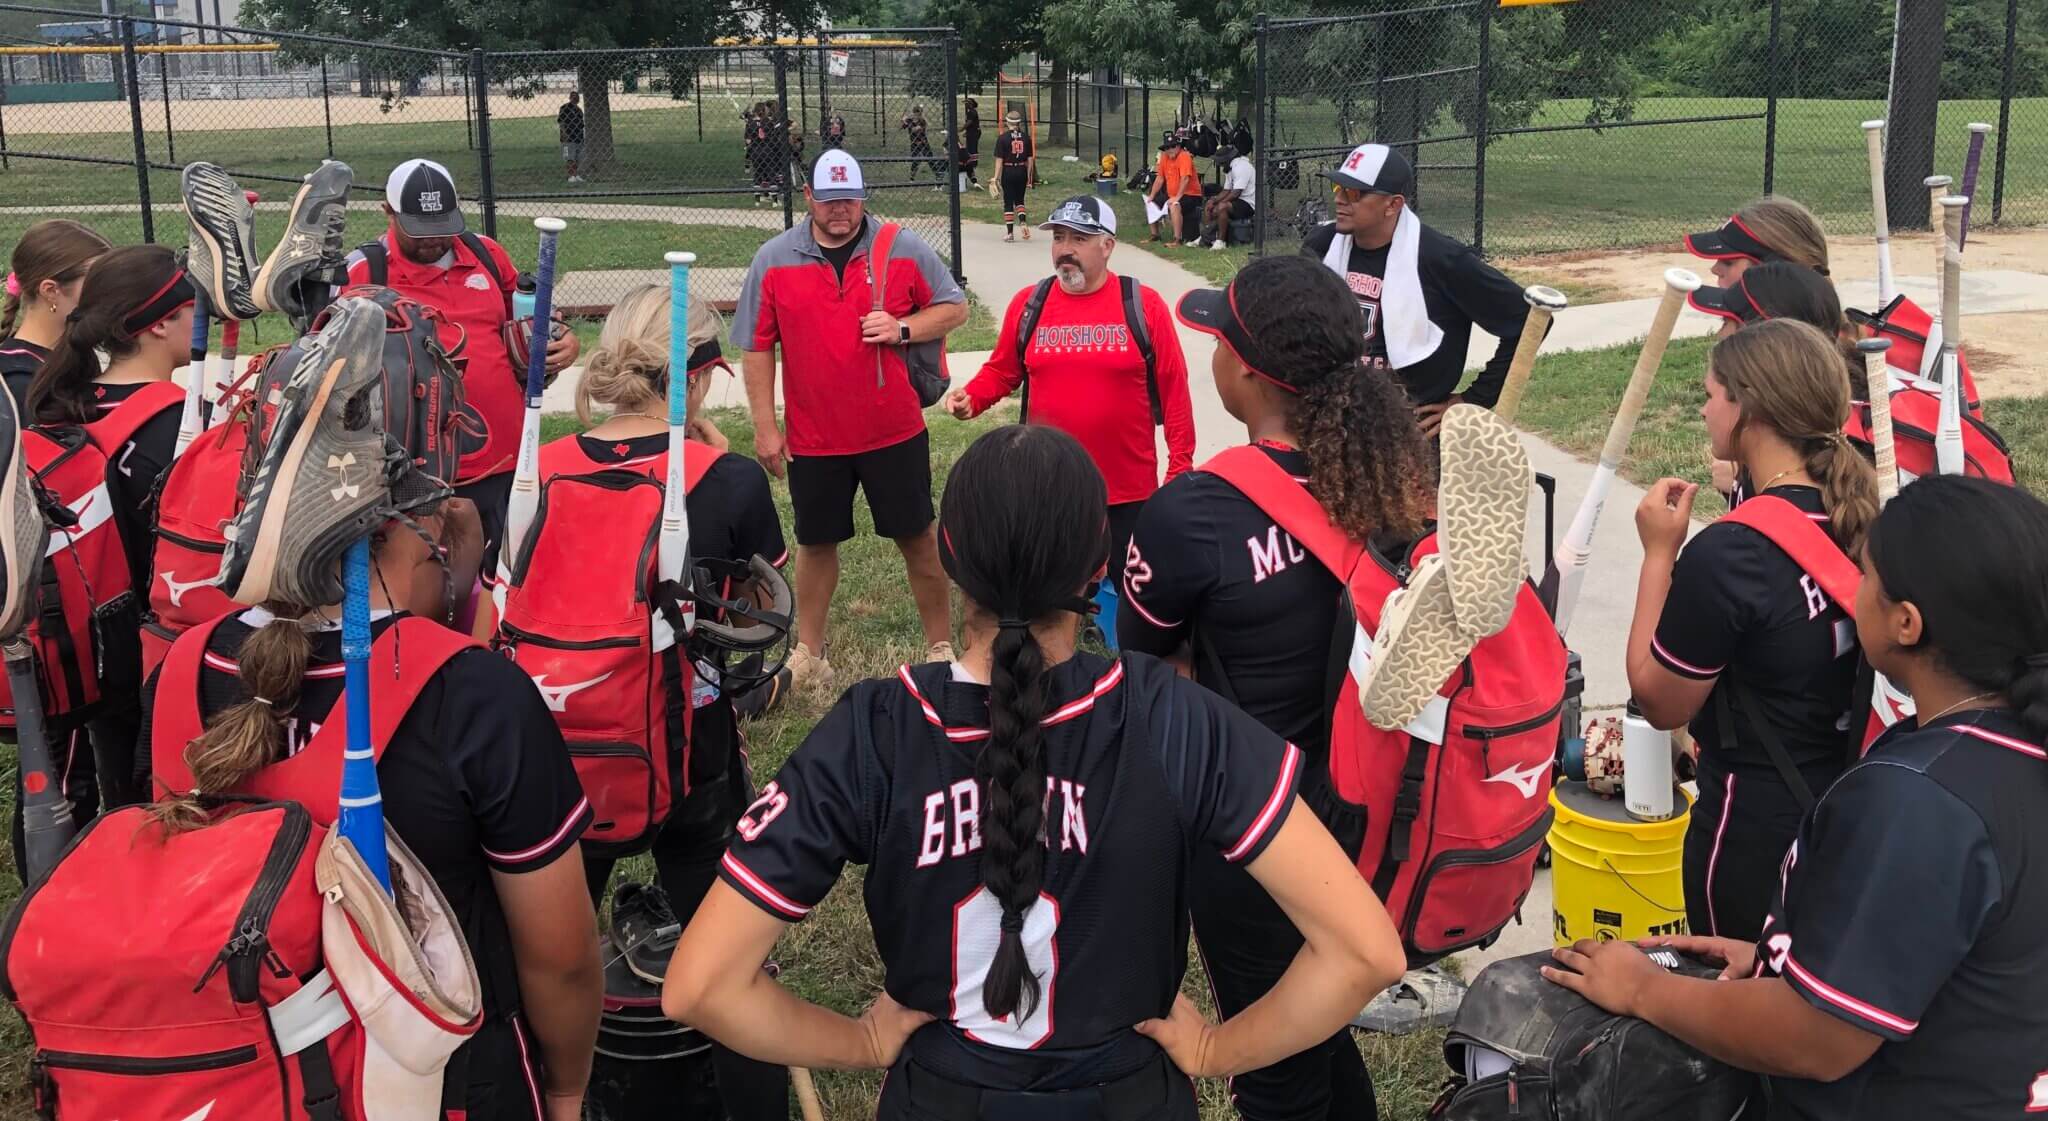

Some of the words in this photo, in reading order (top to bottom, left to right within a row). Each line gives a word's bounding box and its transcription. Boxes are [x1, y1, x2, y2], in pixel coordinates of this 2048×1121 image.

[831, 166, 848, 183] H
[1036, 324, 1128, 347] HOTSHOTS
[1035, 345, 1128, 354] FASTPITCH
[736, 780, 789, 842] 23
[916, 777, 1088, 868] BRN
